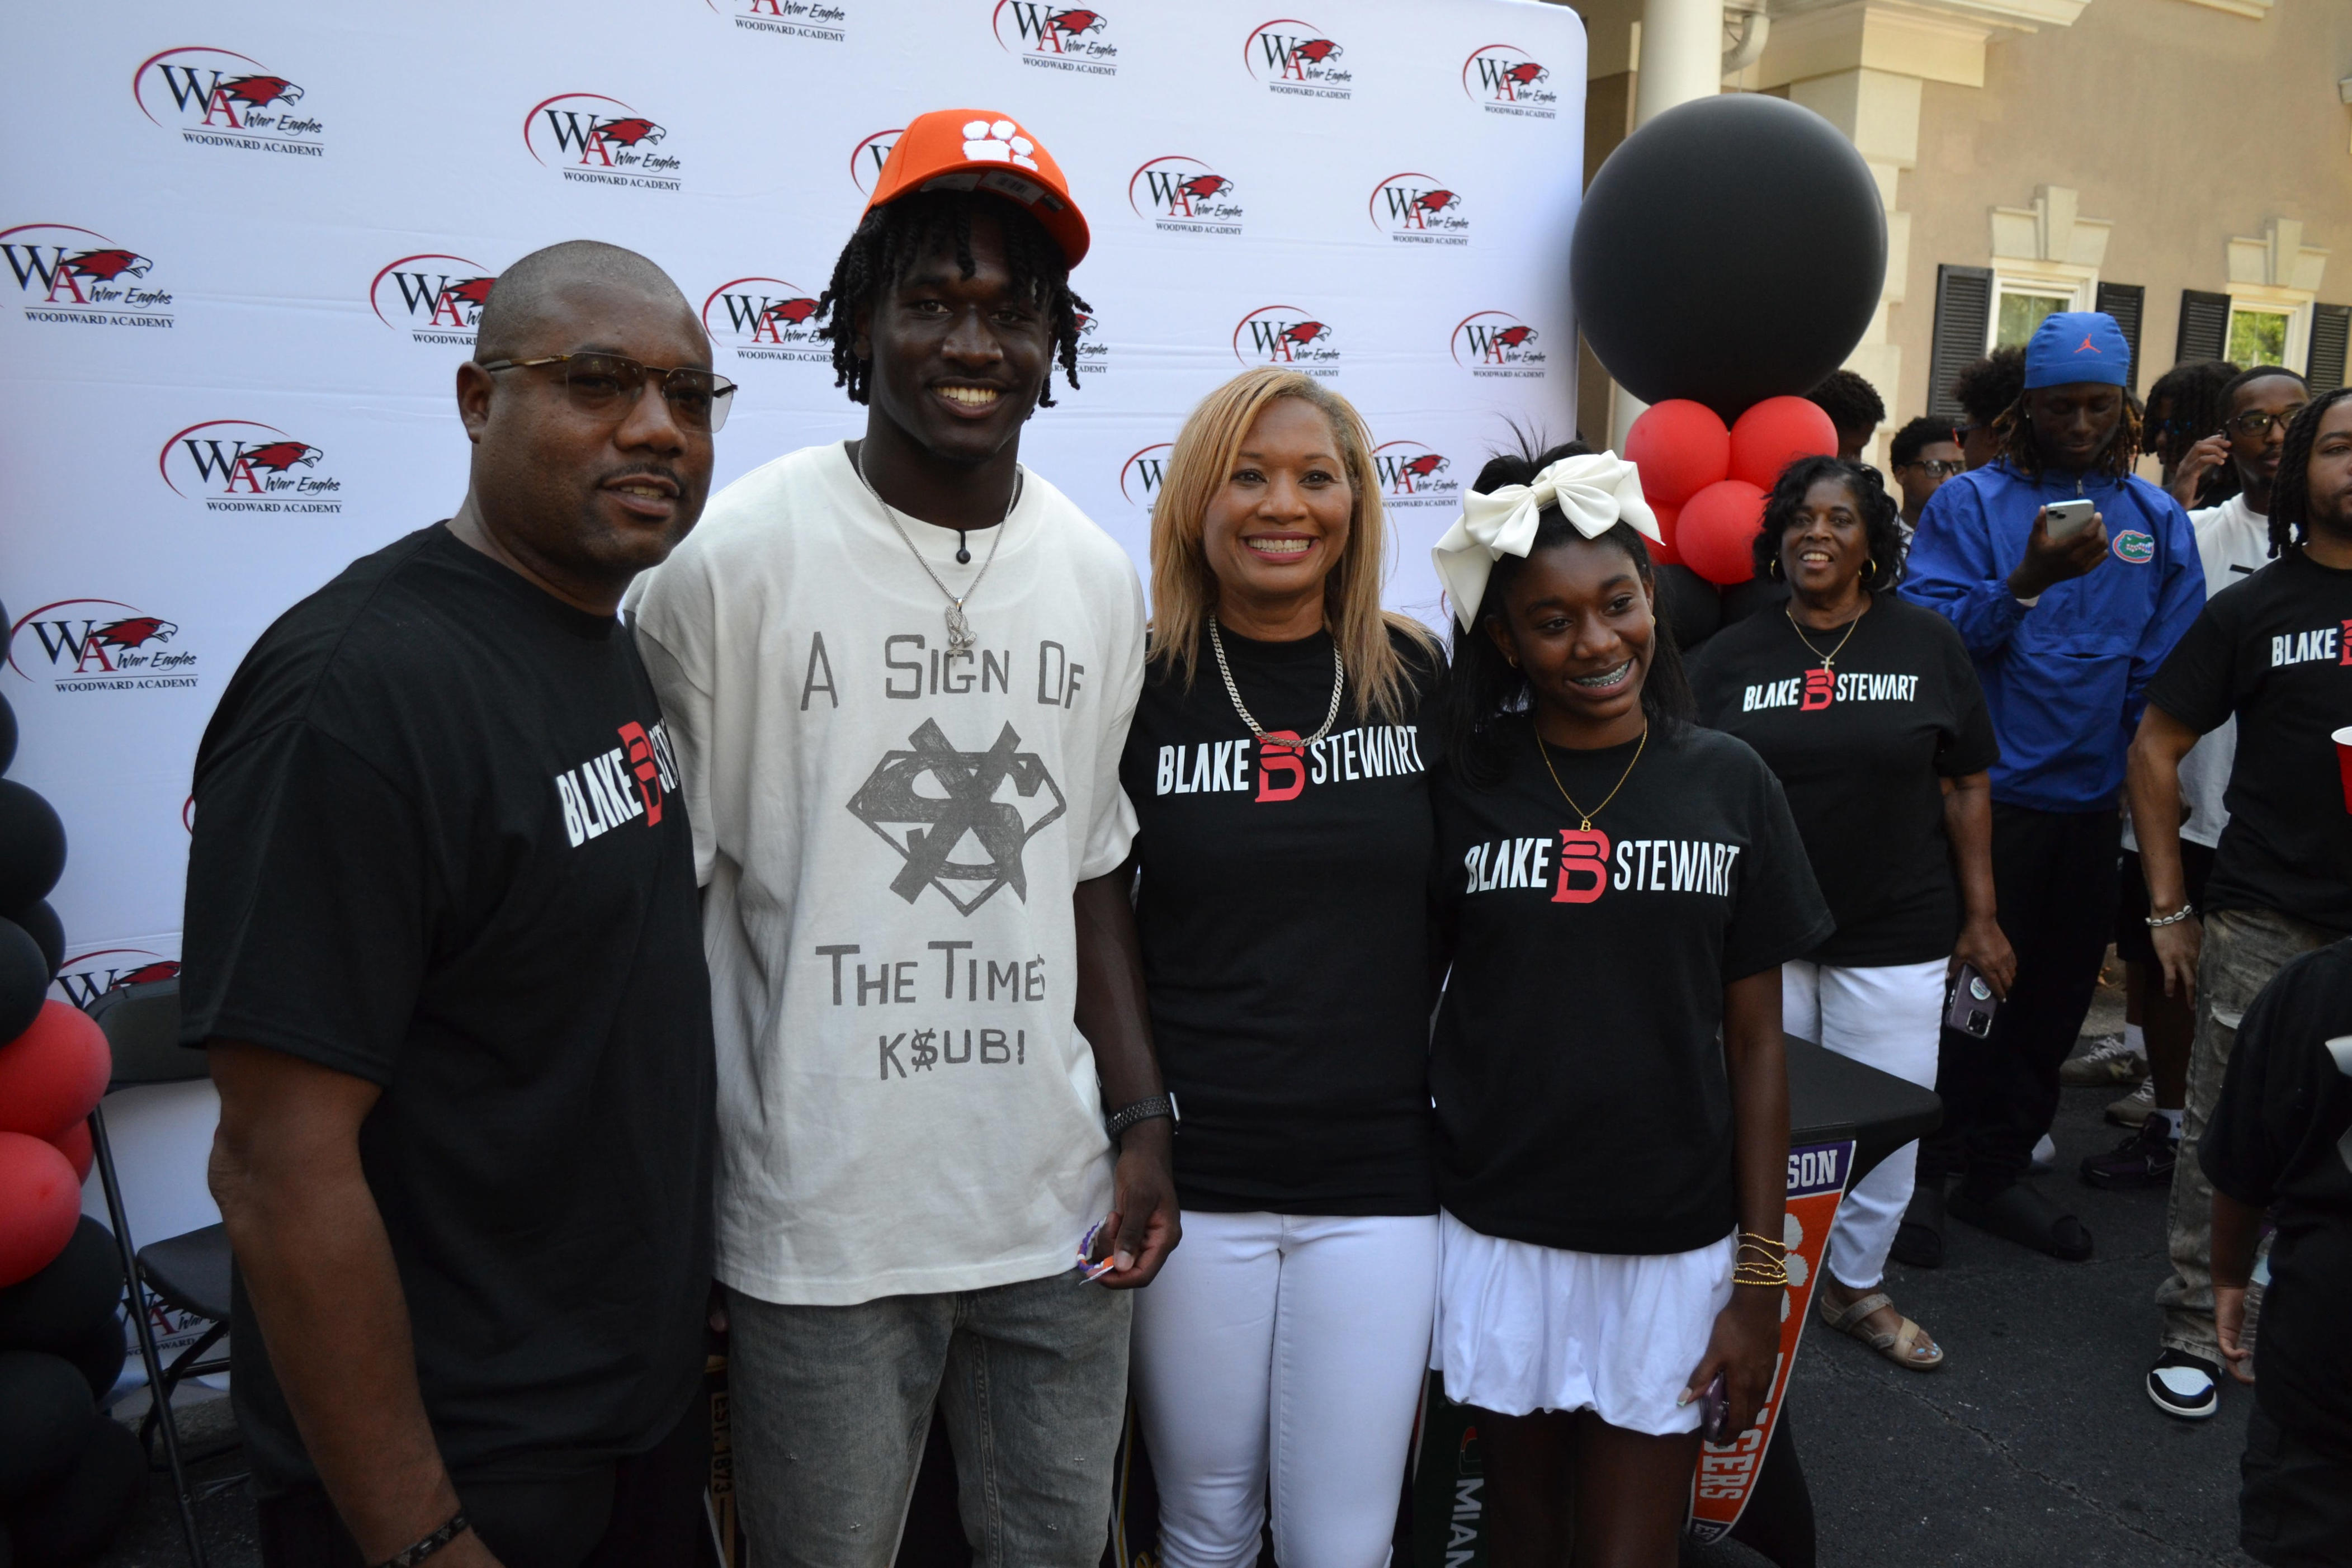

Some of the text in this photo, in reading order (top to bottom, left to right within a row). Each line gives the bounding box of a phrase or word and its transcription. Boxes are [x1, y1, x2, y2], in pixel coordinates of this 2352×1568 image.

[783, 0, 807, 15] War
[809, 3, 845, 23] Eagles
[735, 19, 845, 42] WOODWARD ACADEMY
[1064, 39, 1117, 59] War Eagles
[1023, 57, 1116, 75] WOODWARD ACADEMY
[1305, 66, 1352, 84] War Eagles
[1270, 85, 1351, 100] WOODWARD ACADEMY
[243, 111, 323, 136] War Eagles
[183, 134, 324, 157] WOODWARD ACADEMY
[615, 152, 681, 172] War Eagles
[564, 172, 681, 191] WOODWARD ACADEMY
[1194, 202, 1243, 220] War Eagles
[1156, 223, 1242, 235] WOODWARD ACADEMY
[1392, 235, 1468, 245] WOODWARD ACADEMY
[90, 286, 172, 308] War Eagles
[25, 313, 174, 328] WOODWARD ACADEMY
[412, 334, 477, 345] WOODWAR
[782, 329, 807, 342] War
[737, 350, 834, 362] WOODWARD ACADEM
[1078, 343, 1108, 358] Eagles
[265, 476, 341, 495] War Eagles
[207, 502, 342, 513] WOODWARD ACADEMY
[2271, 628, 2337, 667] BLAKE
[117, 652, 196, 670] War Eagles
[801, 631, 1084, 711] A SIGN OF
[55, 678, 198, 693] WOODWARD ACADEMY
[1742, 678, 1801, 712] BLAKE
[1836, 673, 1919, 702] STEWART
[1157, 739, 1250, 796] BLAKE
[1311, 725, 1425, 785] STEWART
[556, 747, 644, 848] BLAKE
[1465, 838, 1552, 894] BLAKE
[1614, 840, 1740, 896] STEWART
[815, 944, 918, 1007] THE
